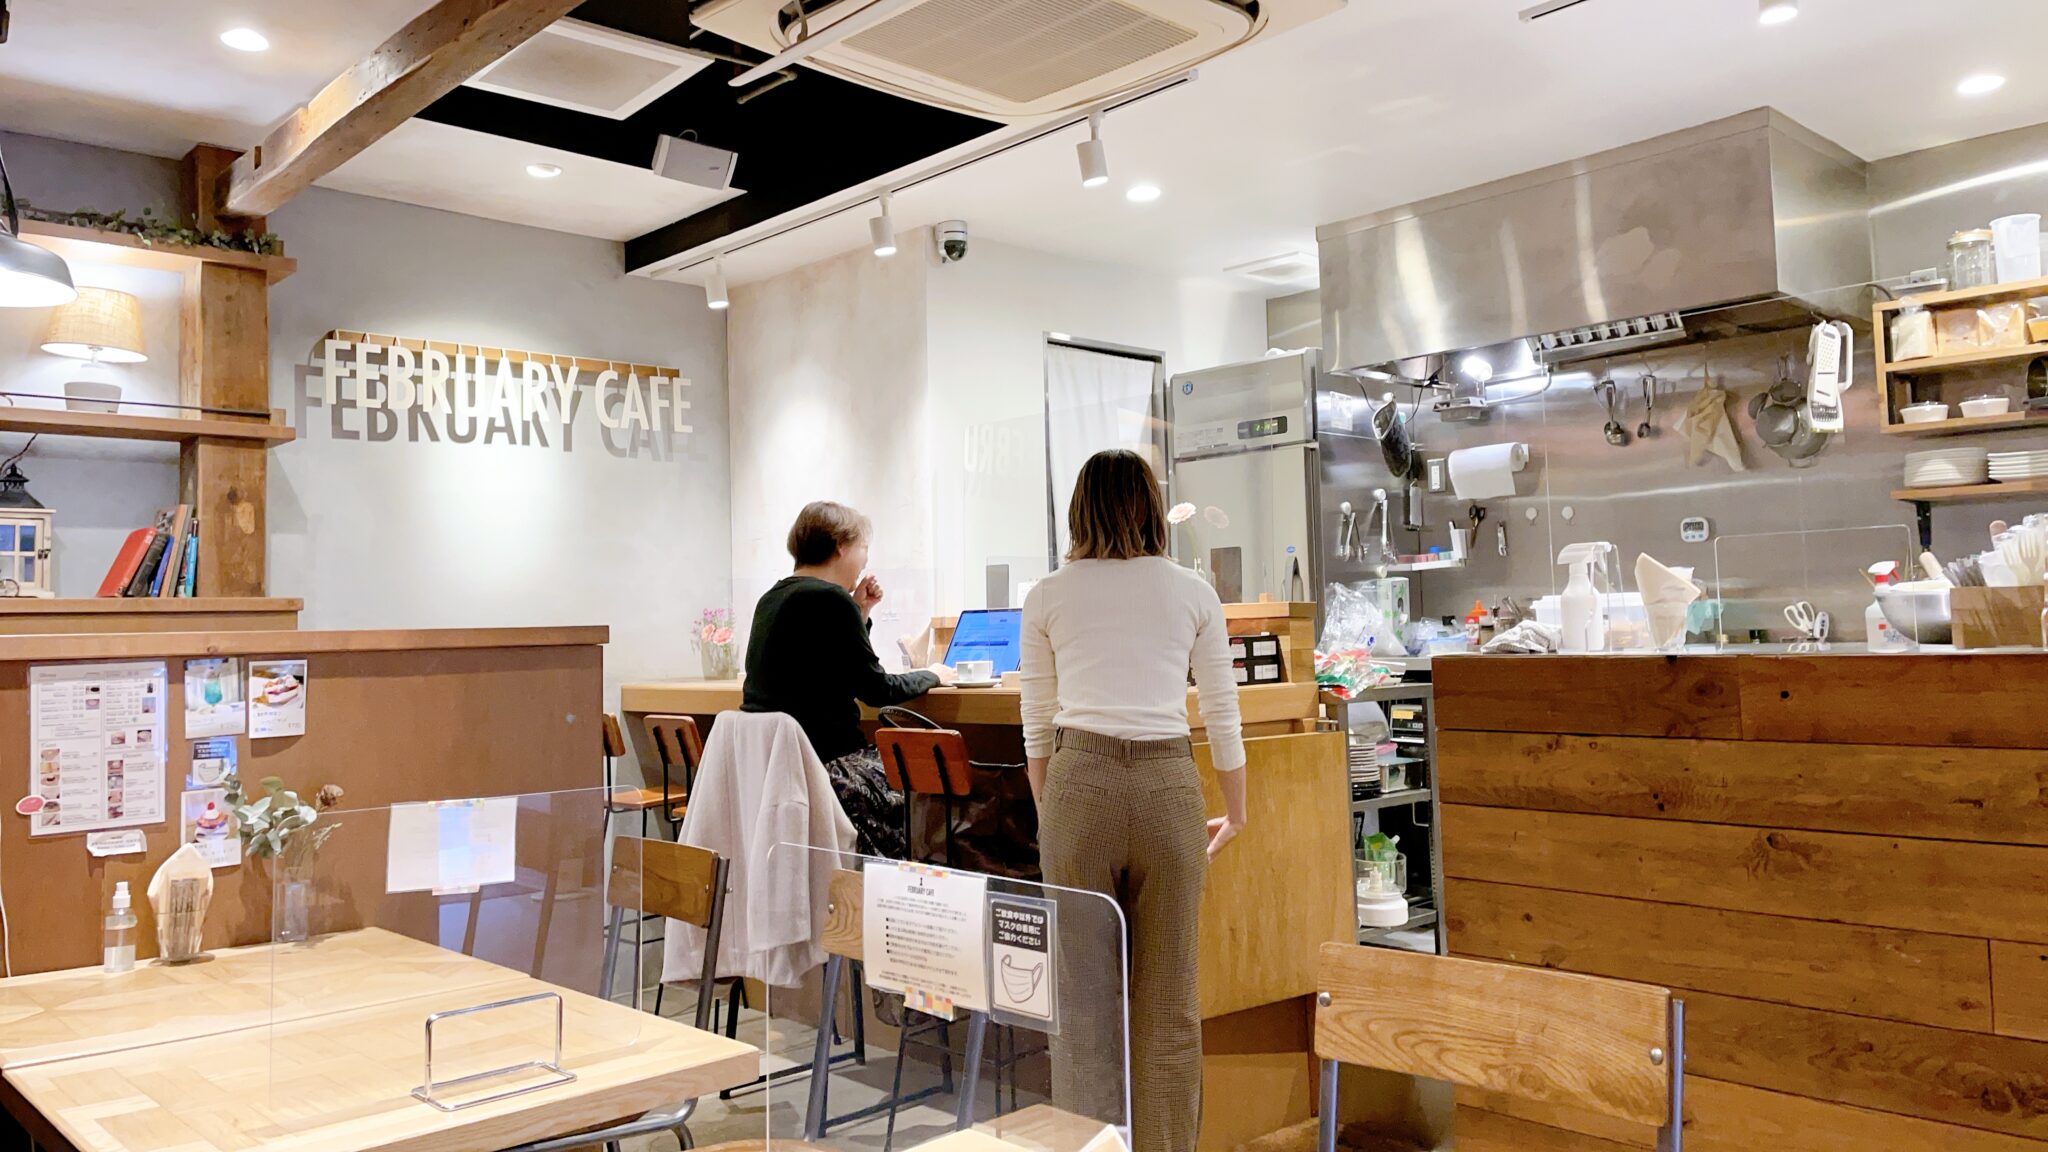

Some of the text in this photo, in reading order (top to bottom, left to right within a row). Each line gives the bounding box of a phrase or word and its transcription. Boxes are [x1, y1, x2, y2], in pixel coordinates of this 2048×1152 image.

[324, 339, 694, 434] FEBRUARY CAFE
[998, 930, 1041, 946] ご協力ください
